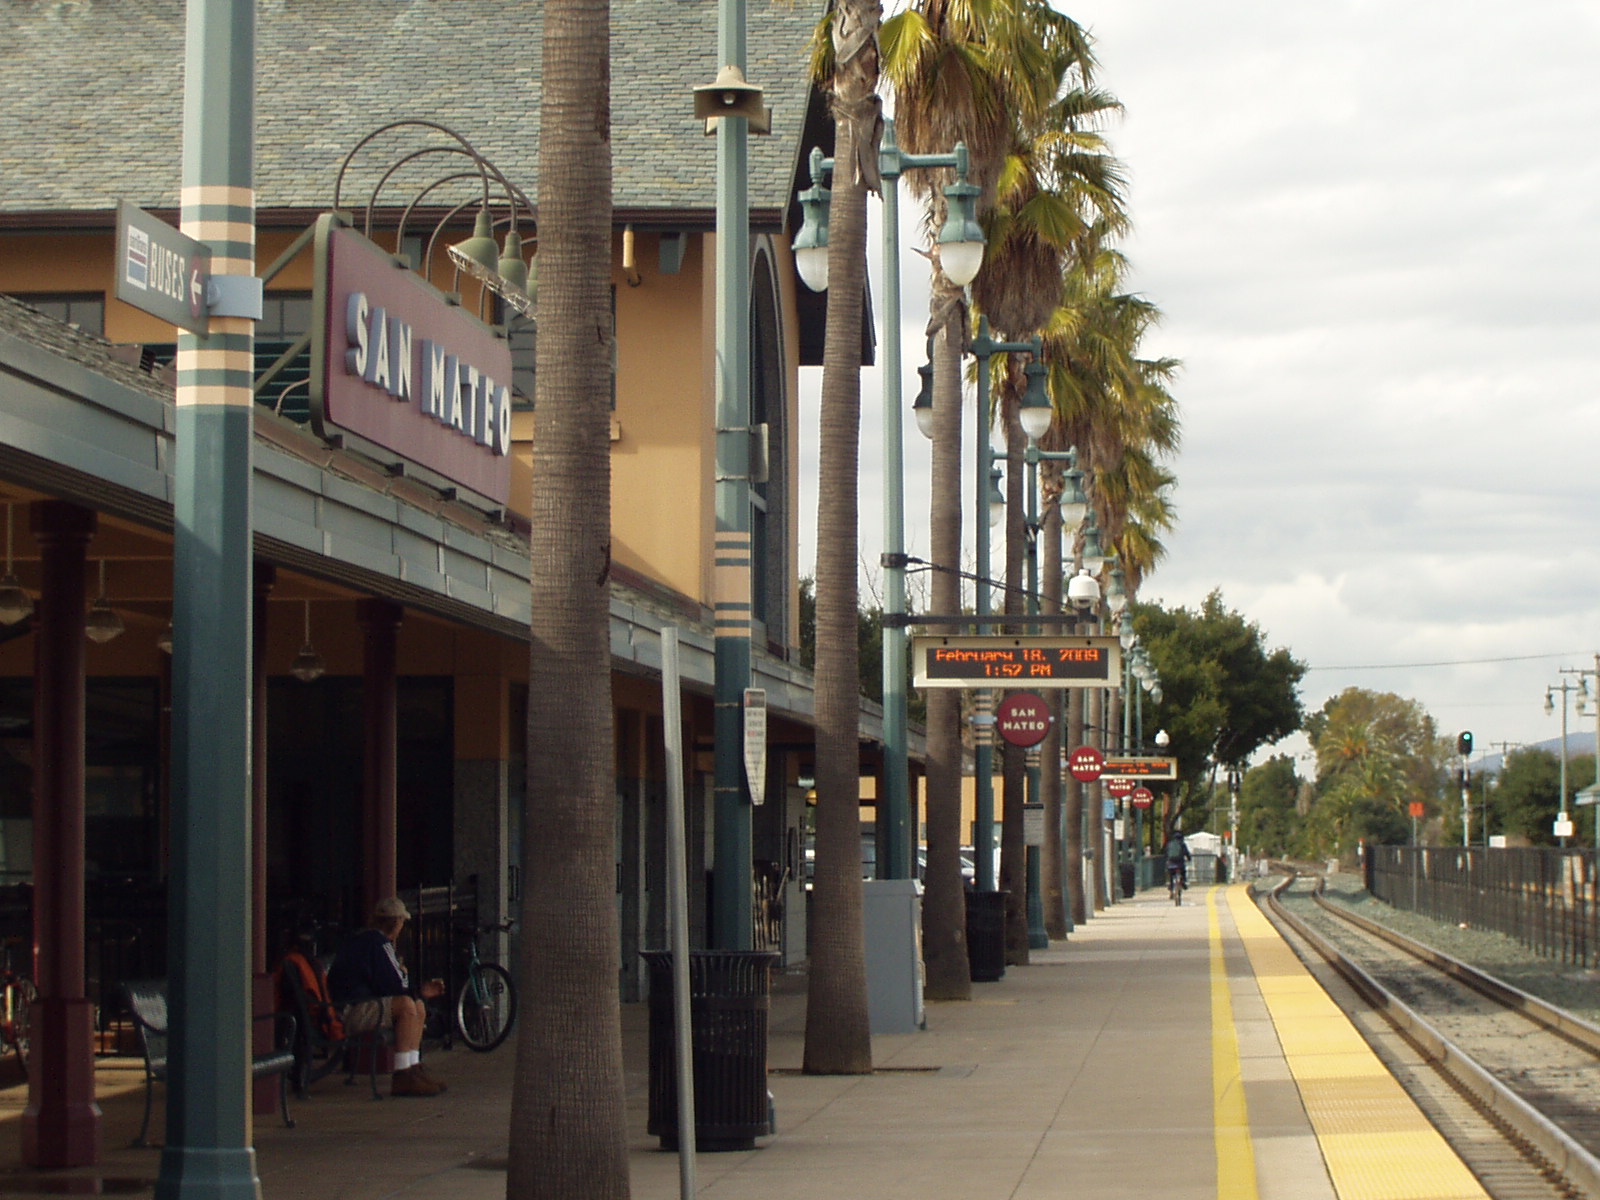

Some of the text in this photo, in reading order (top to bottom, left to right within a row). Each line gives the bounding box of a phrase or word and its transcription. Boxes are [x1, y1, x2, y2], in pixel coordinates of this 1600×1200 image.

[150, 241, 185, 302] BUSES
[346, 292, 511, 458] SAN MATEO
[935, 648, 1014, 662] February
[1030, 663, 1052, 677] PM
[1011, 708, 1036, 717] SAN
[1003, 721, 1045, 730] MATEO
[1072, 764, 1101, 772] MATEO
